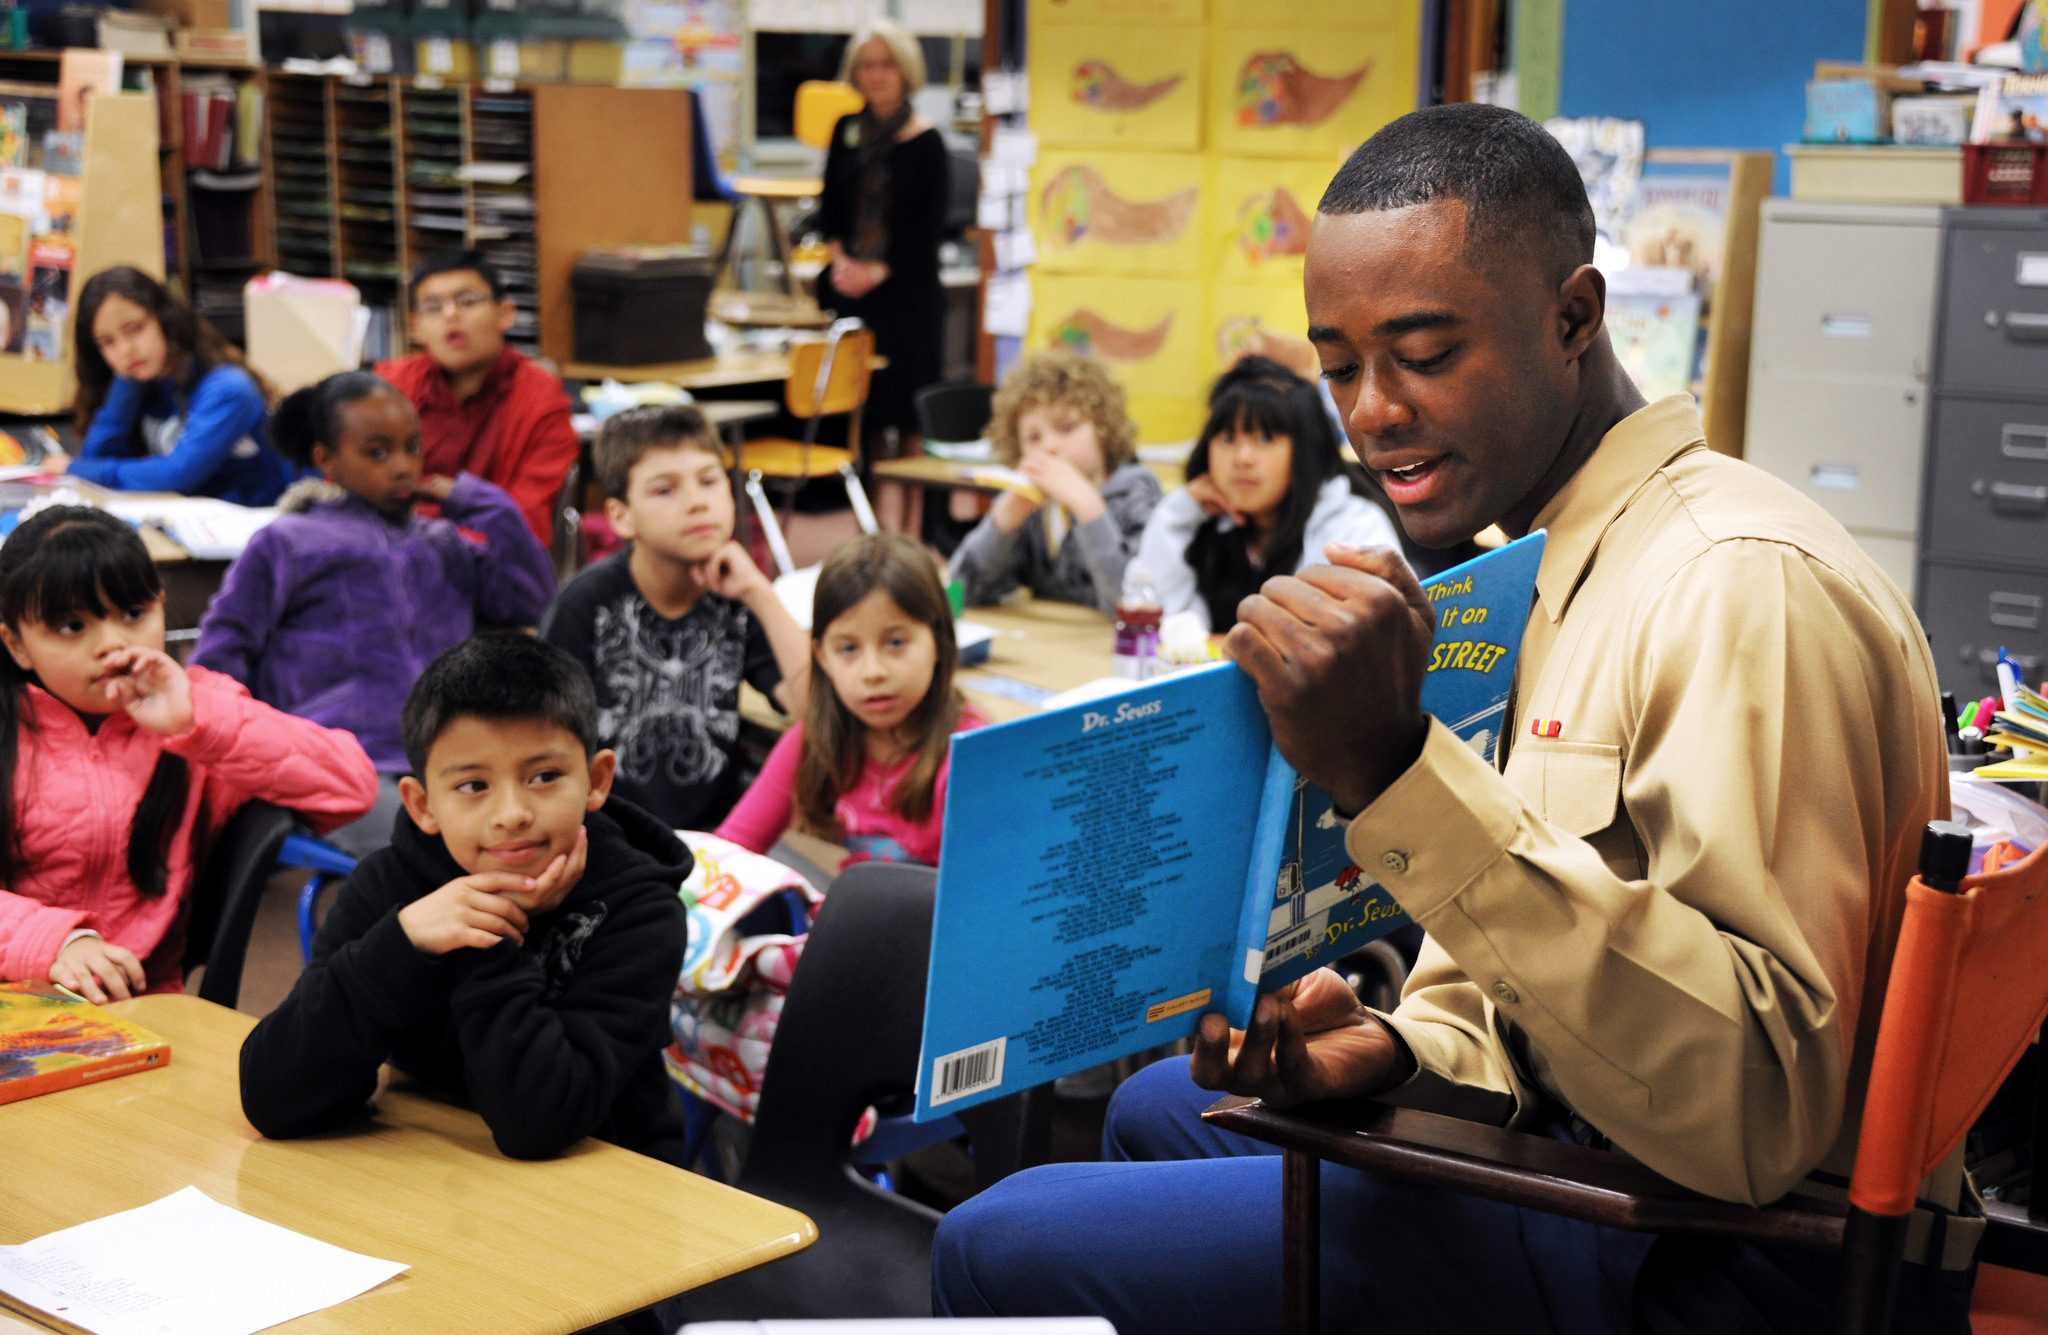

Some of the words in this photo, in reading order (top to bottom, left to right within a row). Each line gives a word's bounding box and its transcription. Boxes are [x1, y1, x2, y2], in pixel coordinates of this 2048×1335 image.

[1426, 575, 1473, 602] Think
[1441, 606, 1459, 628] It
[1461, 607, 1488, 624] on
[1426, 640, 1507, 674] STREET
[1082, 709, 1111, 732] Dr.
[1112, 699, 1162, 724] Seuss
[1325, 916, 1354, 945] Dr.
[1358, 898, 1403, 927] Seuss
